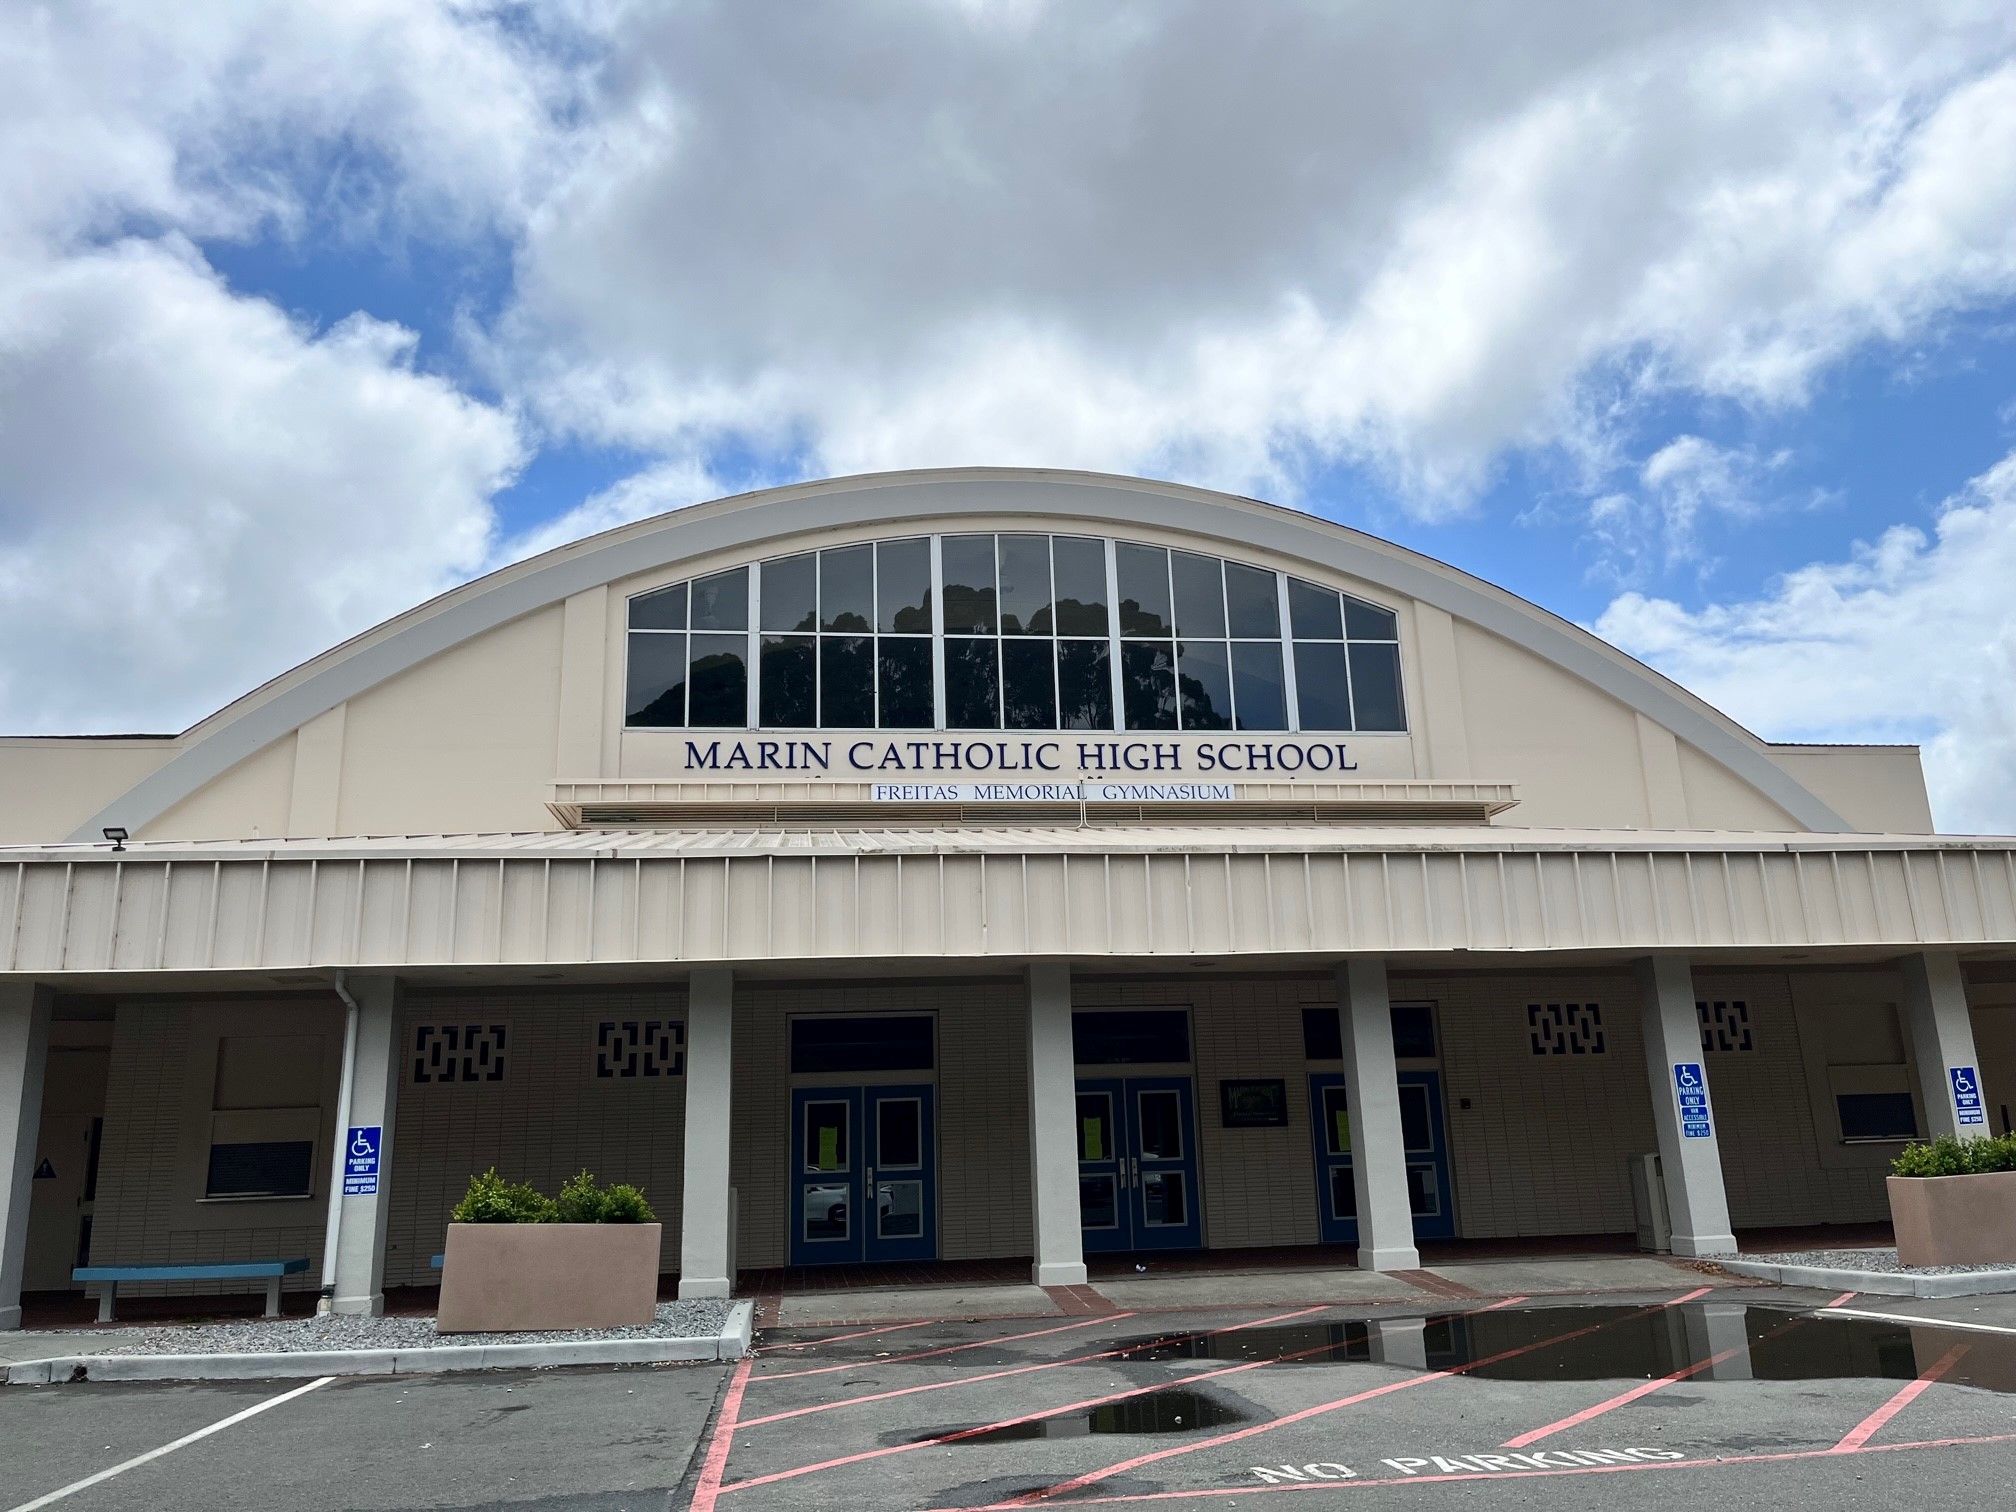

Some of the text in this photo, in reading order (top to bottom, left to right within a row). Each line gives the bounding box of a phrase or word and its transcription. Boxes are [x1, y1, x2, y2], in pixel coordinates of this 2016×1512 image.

[684, 741, 1358, 772] MARIN CATHOLIC HIGH SCHOOL
[876, 785, 1231, 801] FREITAS MEMORIAL GYMNASIUM
[1679, 1086, 1704, 1096] PARKING
[1685, 1096, 1700, 1105] ONLY
[349, 1157, 376, 1165] PARKING
[346, 1177, 376, 1185] MINIMUM
[344, 1184, 376, 1193] FINE $250
[1250, 1446, 1686, 1484] NO PARKING
